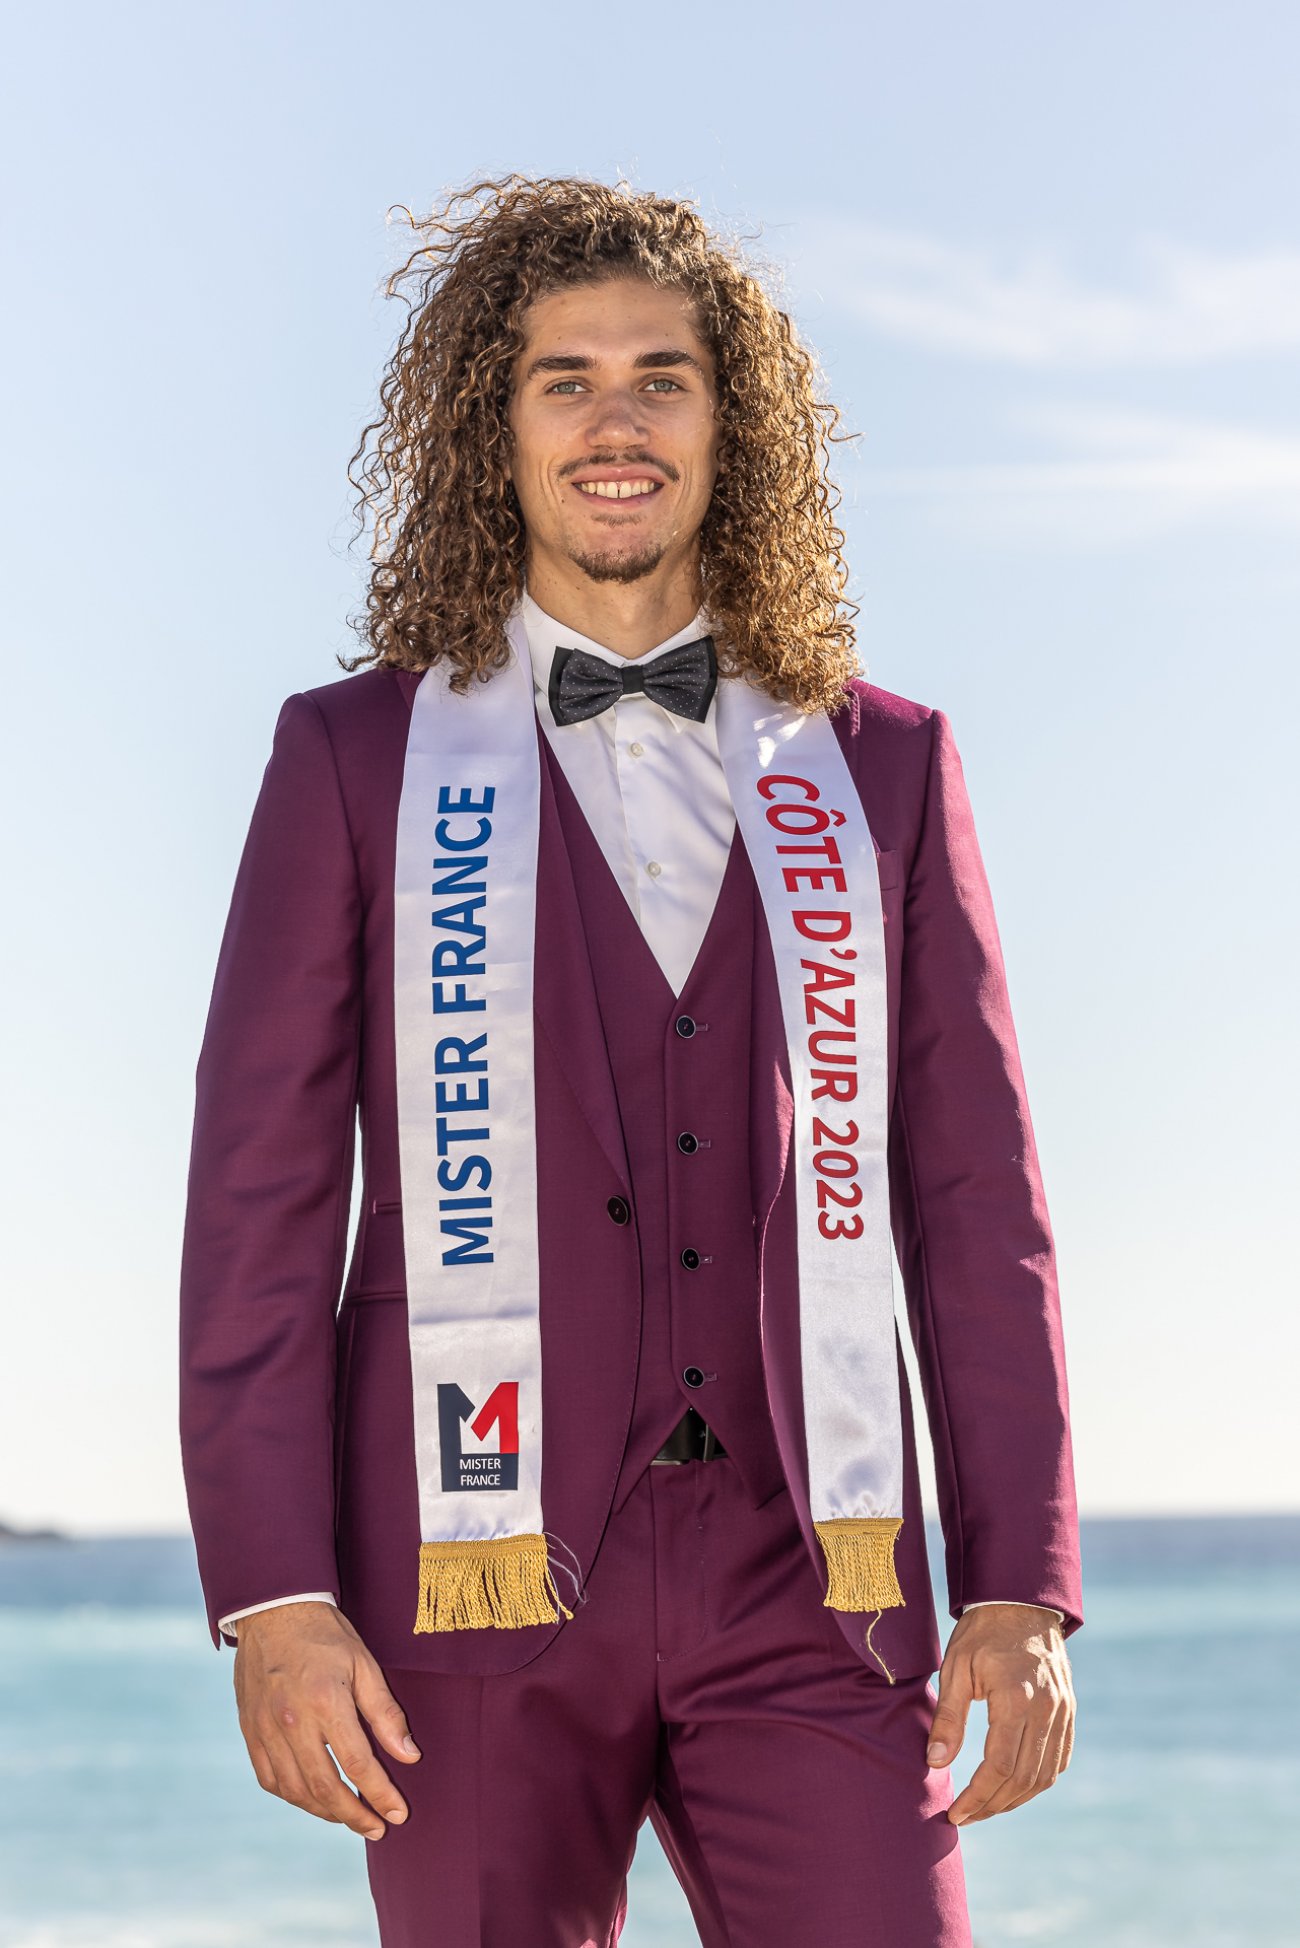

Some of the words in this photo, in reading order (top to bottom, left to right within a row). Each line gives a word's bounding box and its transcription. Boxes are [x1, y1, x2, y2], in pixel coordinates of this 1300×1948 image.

[432, 785, 496, 1015] FRANCE
[755, 773, 848, 894] CÔTE
[811, 1117, 865, 1242] 2023
[435, 1032, 495, 1267] MISTER
[459, 1458, 501, 1470] MISTER
[460, 1474, 501, 1486] FRANCE
